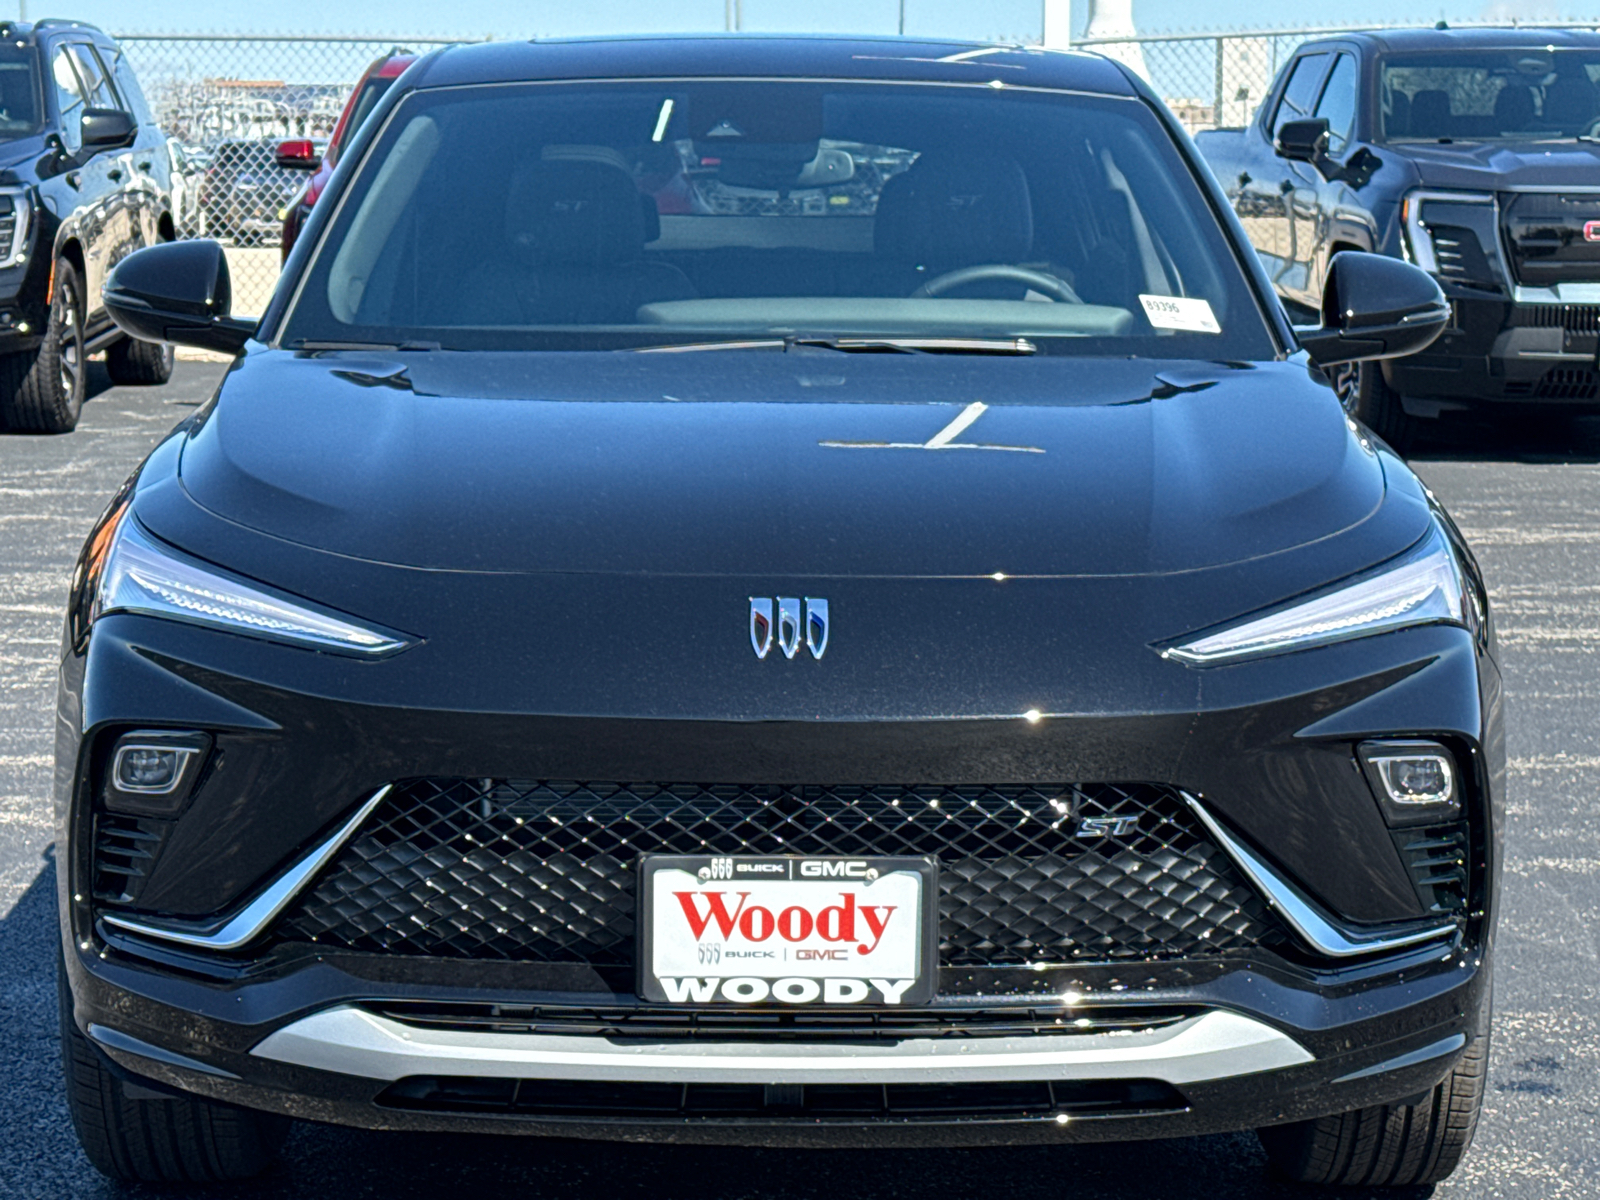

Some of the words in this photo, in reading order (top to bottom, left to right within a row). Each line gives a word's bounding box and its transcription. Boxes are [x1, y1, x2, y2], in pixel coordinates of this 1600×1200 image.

[1076, 816, 1138, 837] ST
[736, 863, 785, 873] BUICK
[800, 861, 867, 877] GMC
[672, 891, 898, 956] Woody
[725, 950, 775, 959] BUICK
[796, 949, 849, 961] GMC
[659, 977, 916, 1004] WOODY
